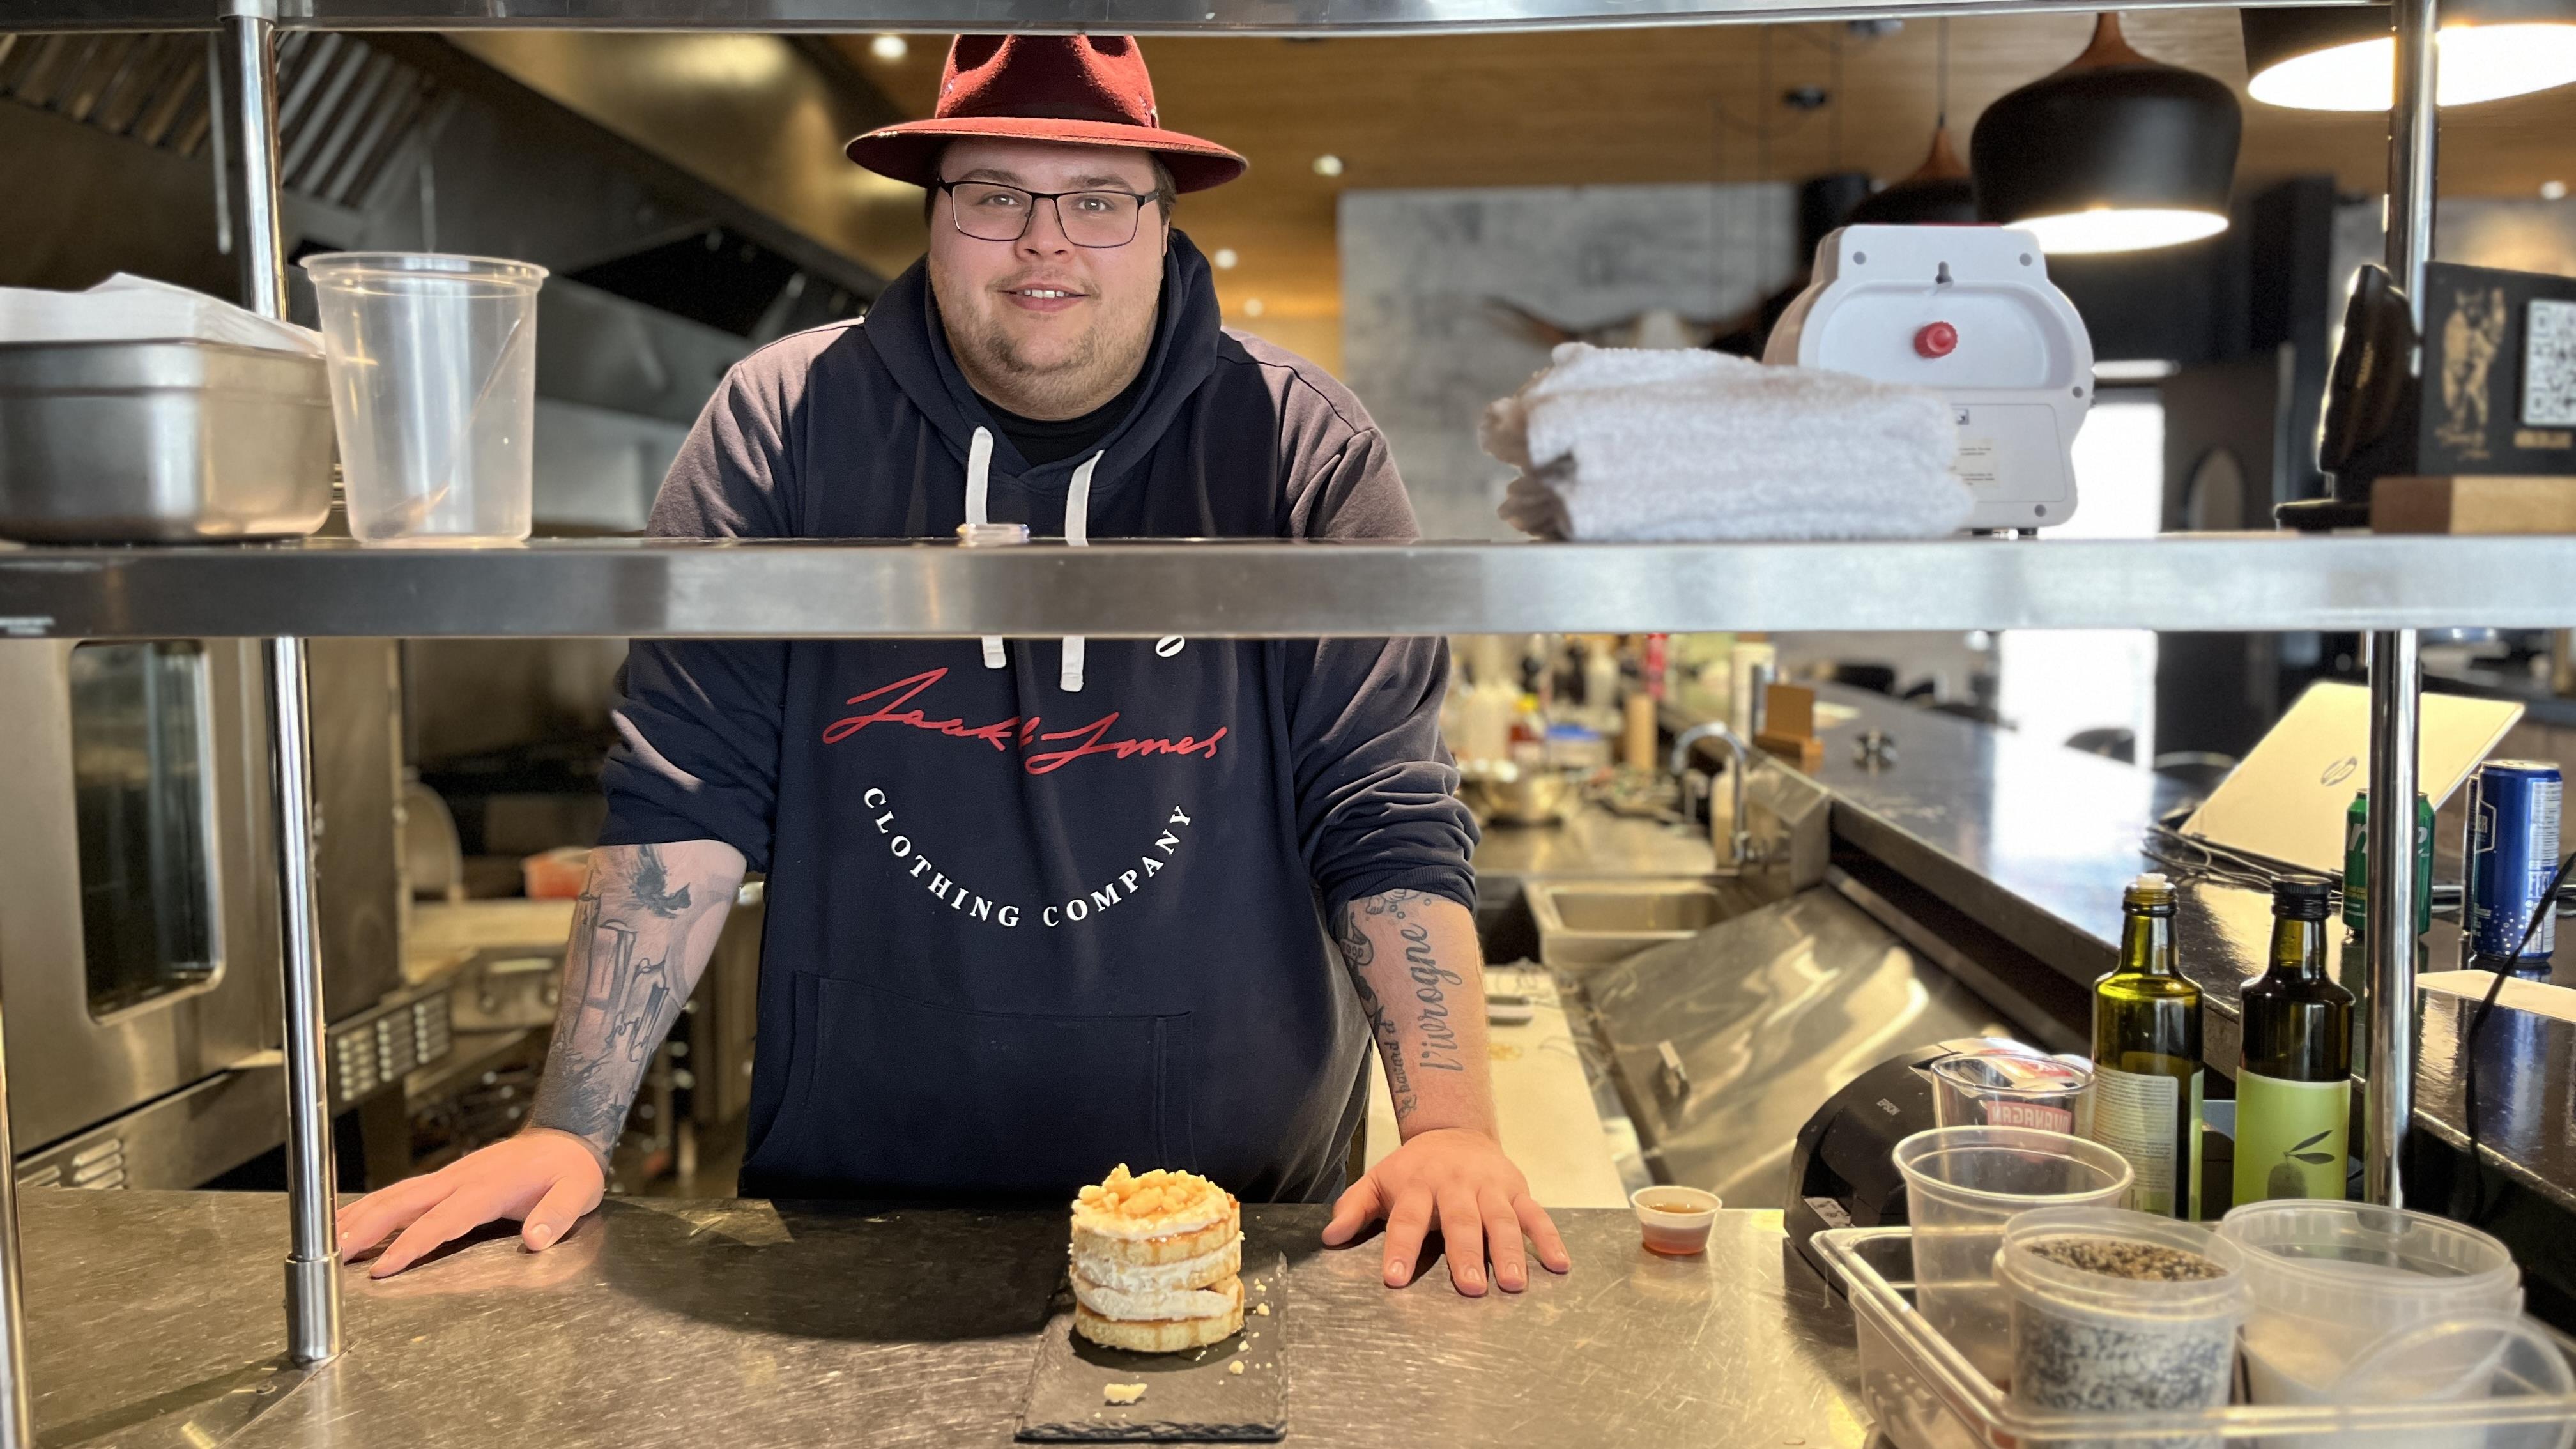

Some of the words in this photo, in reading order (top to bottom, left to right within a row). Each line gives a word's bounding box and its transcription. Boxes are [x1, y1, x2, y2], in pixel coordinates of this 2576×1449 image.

[1025, 711, 1228, 775] Jones
[864, 787, 1020, 927] CLOTHING
[1043, 805, 1191, 928] COMPANY
